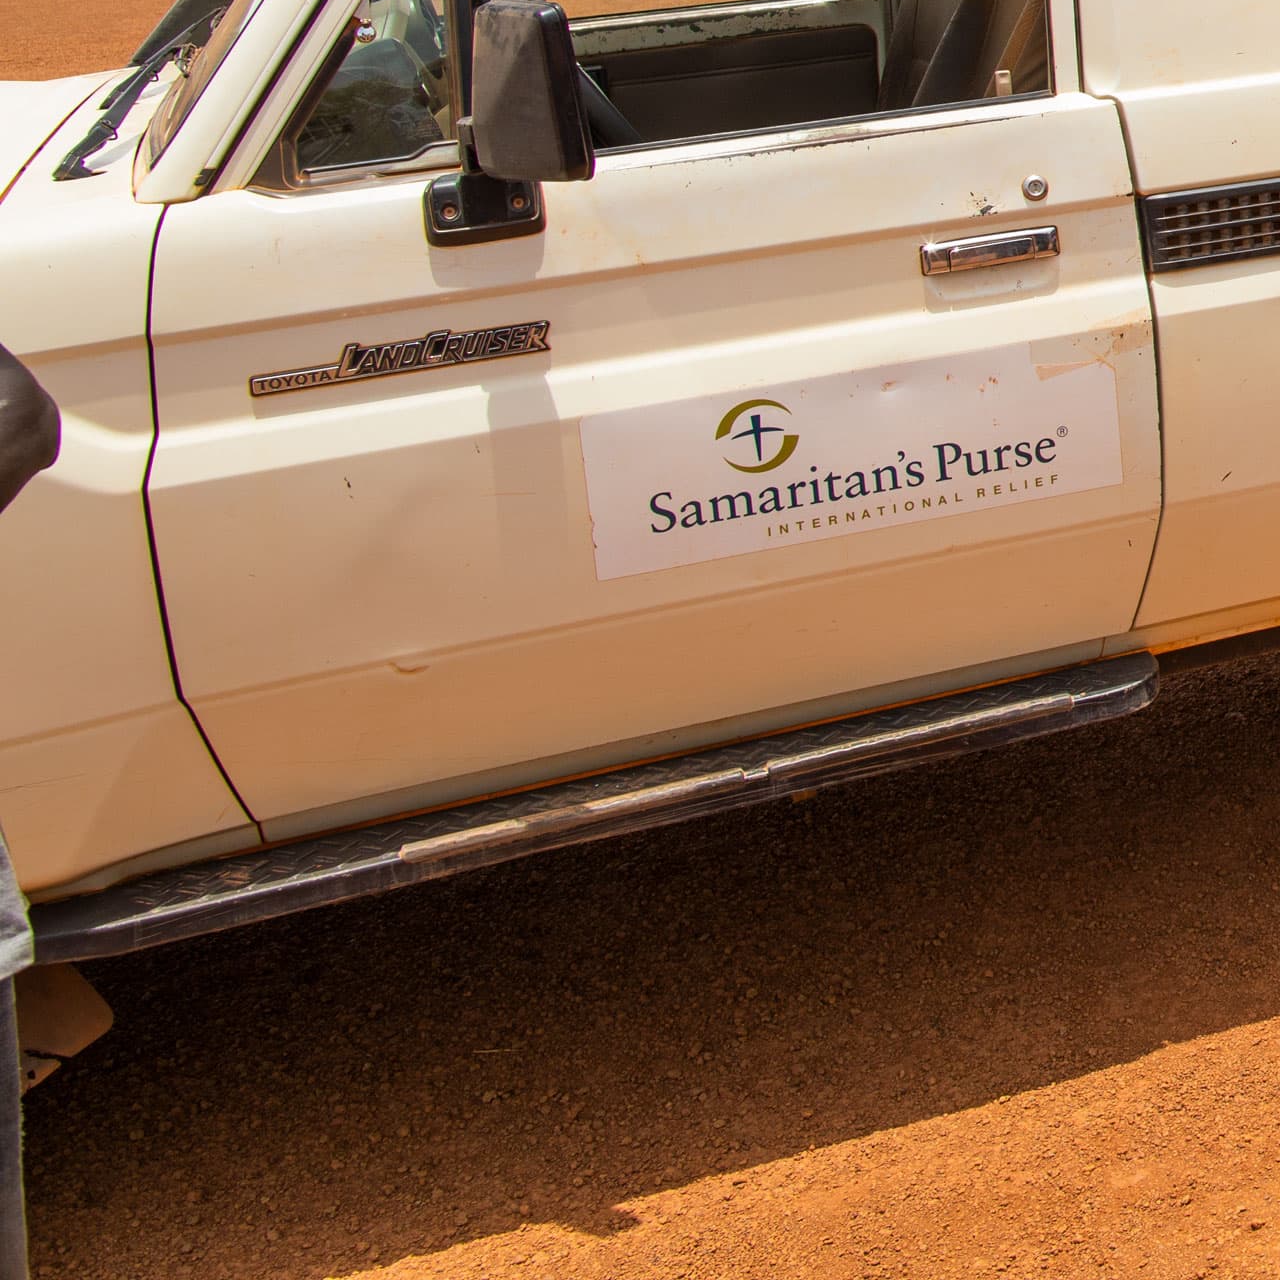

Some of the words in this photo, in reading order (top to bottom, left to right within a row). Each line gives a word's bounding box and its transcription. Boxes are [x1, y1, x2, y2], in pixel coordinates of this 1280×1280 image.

[256, 371, 330, 392] TOYOTA
[648, 450, 926, 534] Samaritan's
[766, 490, 965, 538] INTERNATIONAL
[976, 473, 1061, 500] RELIEF
